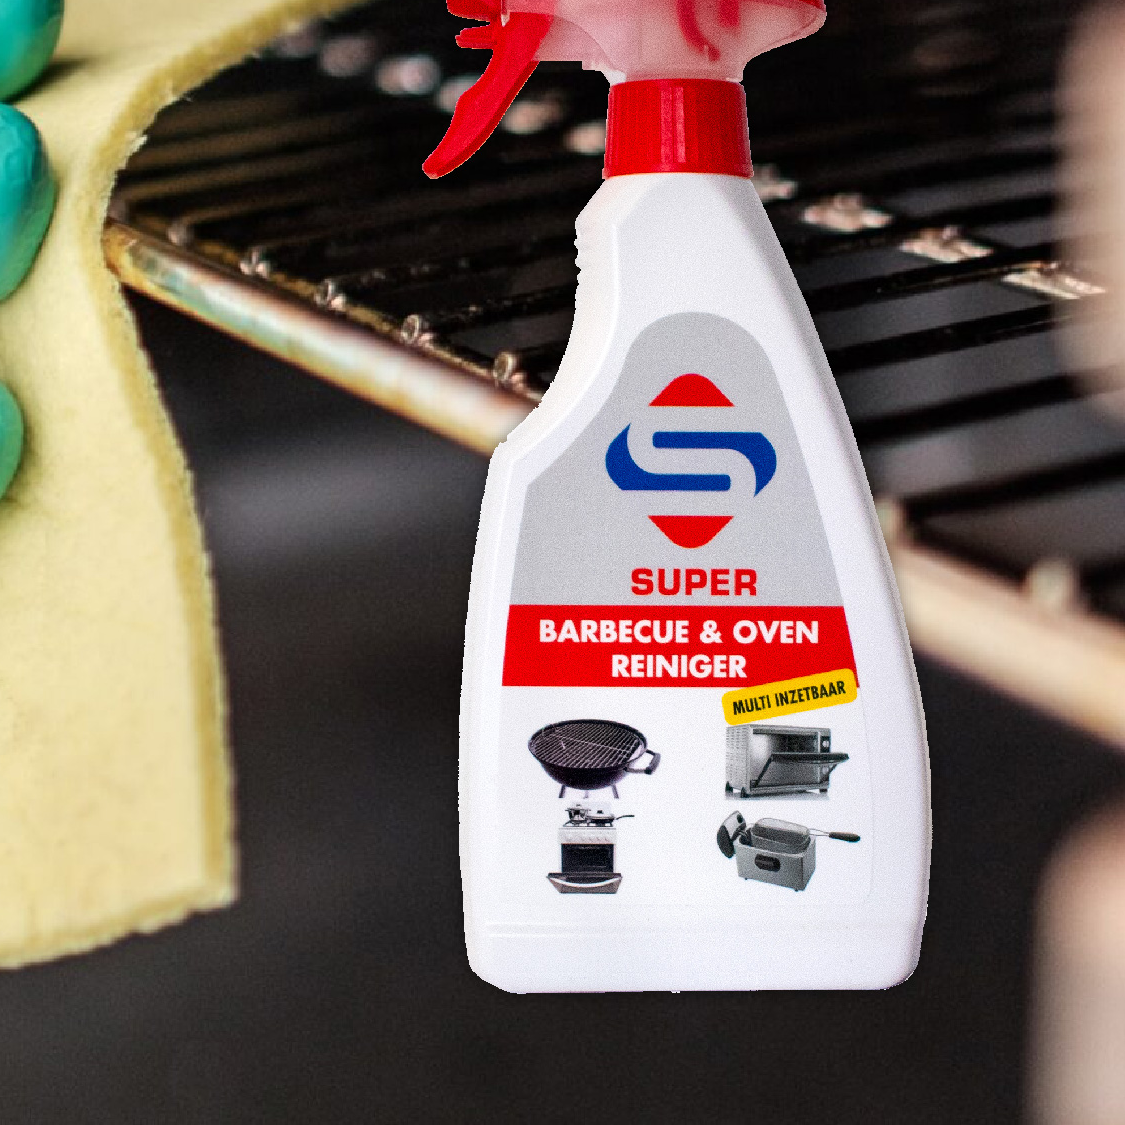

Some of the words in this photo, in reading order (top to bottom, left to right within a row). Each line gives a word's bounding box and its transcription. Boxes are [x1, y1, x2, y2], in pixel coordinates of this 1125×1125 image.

[631, 567, 758, 596] SUPER
[539, 619, 689, 644] BARBECUE
[699, 620, 724, 644] &
[732, 620, 819, 644] OVEN
[611, 655, 748, 678] REINIGER
[732, 694, 772, 715] MULTI
[774, 680, 847, 707] INZETBAAR
